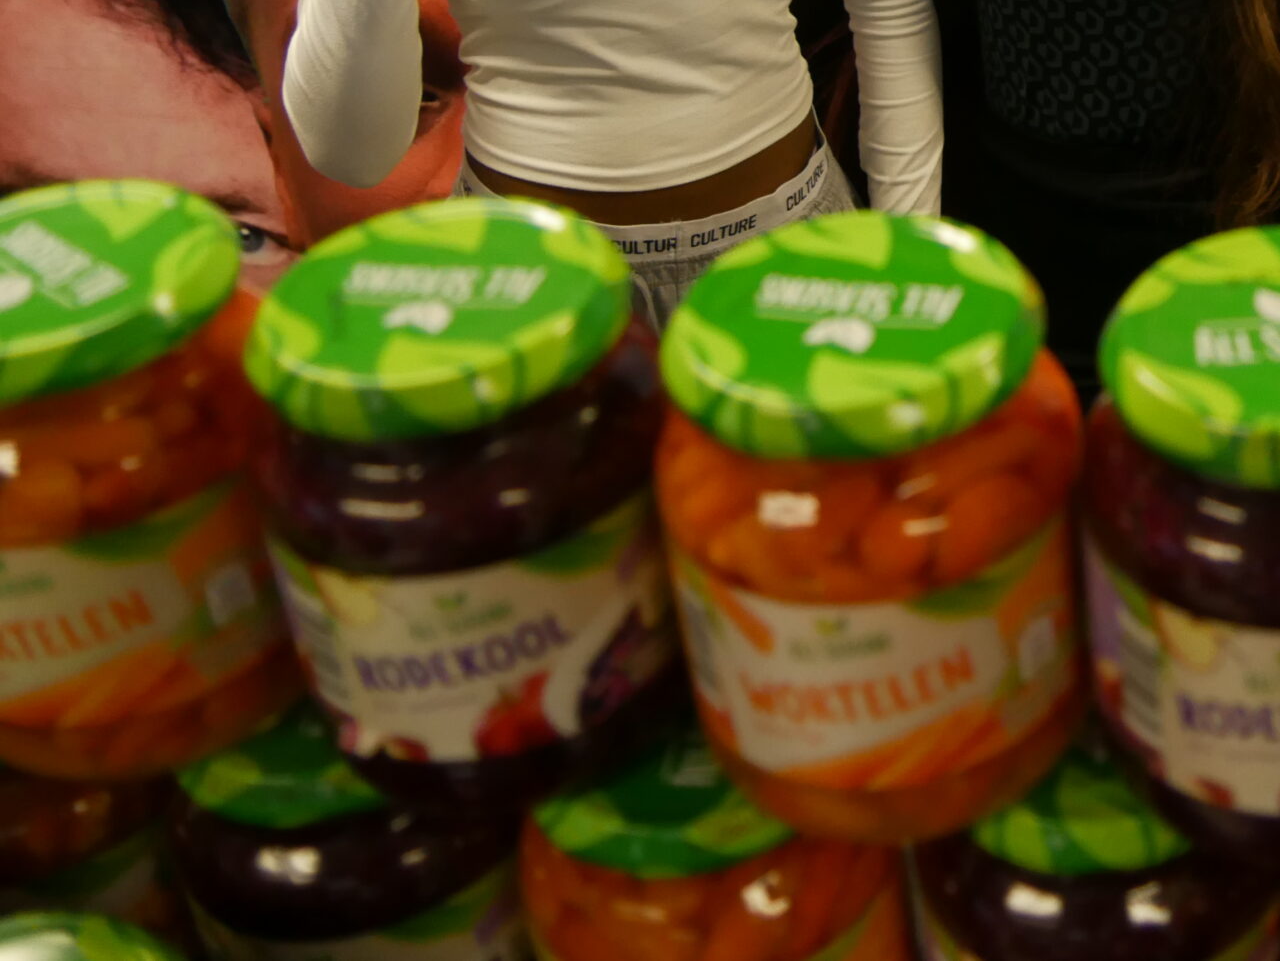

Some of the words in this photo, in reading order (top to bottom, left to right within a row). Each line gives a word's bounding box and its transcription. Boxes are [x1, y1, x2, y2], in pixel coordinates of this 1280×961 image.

[690, 214, 757, 248] CULTURE
[786, 161, 825, 212] CULTURE
[738, 642, 976, 725] WORTELEN
